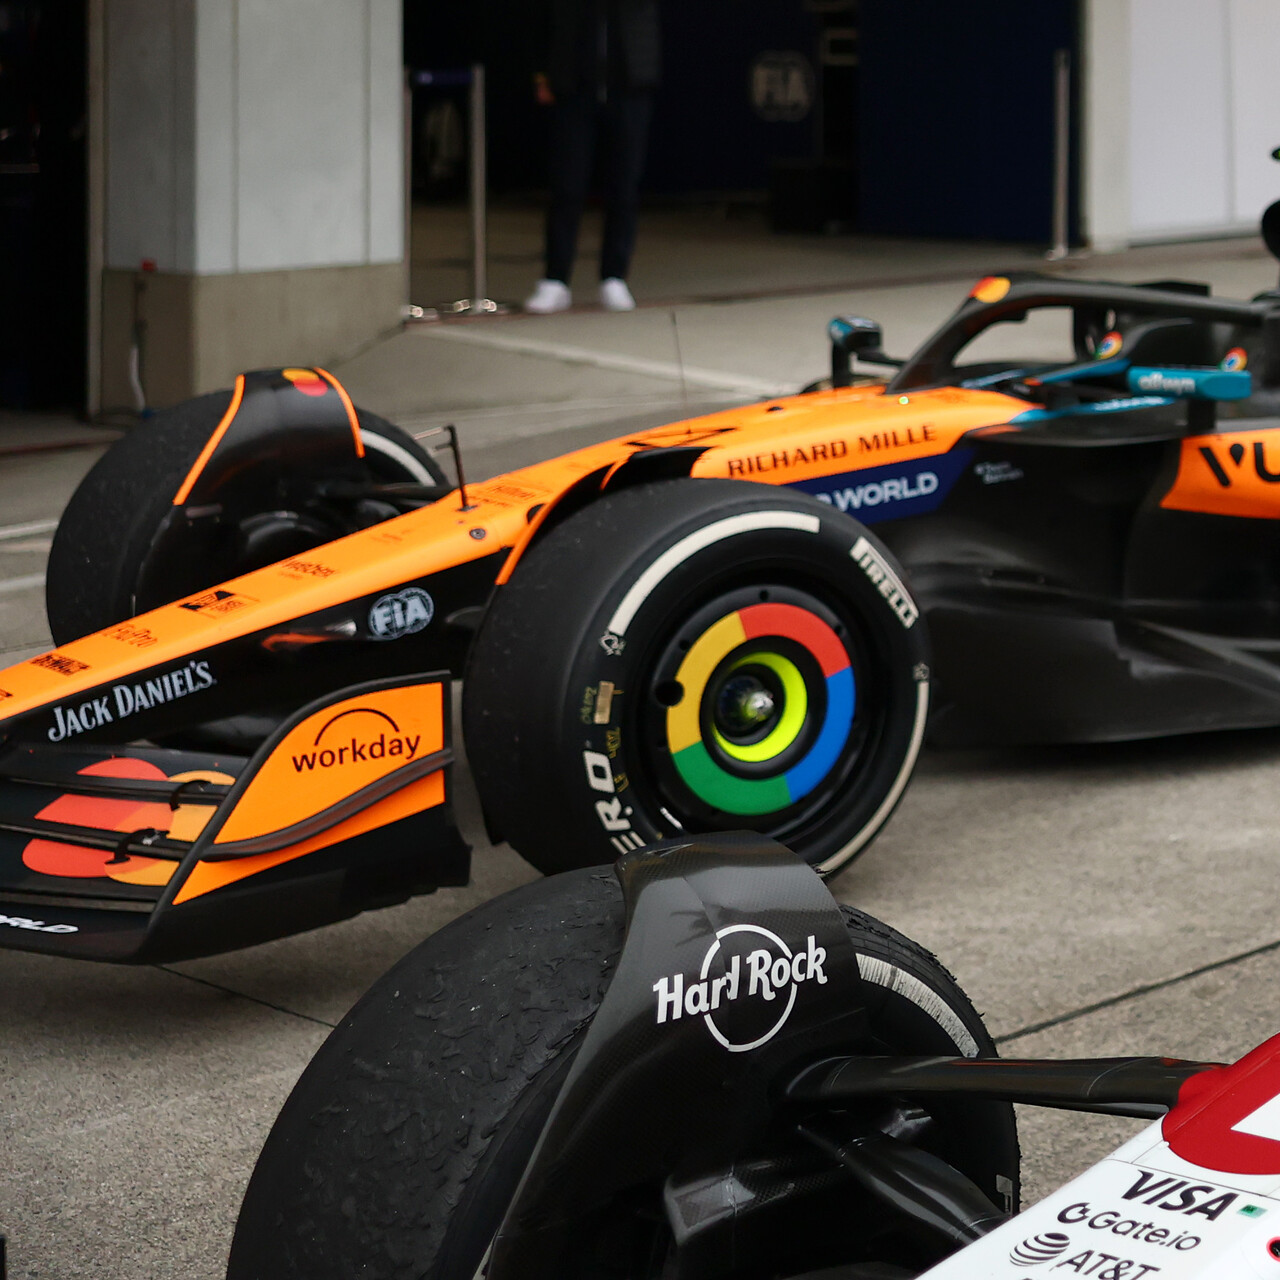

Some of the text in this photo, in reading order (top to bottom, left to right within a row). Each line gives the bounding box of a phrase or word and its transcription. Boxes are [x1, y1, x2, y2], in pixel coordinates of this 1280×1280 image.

[727, 424, 937, 478] RICHARD MILLE
[833, 471, 940, 513] WORLD
[373, 595, 431, 633] FIA
[48, 694, 113, 743] JACK
[113, 660, 213, 719] DANIEL'S
[291, 731, 421, 773] workday
[653, 935, 828, 1025] Hard Rock
[1121, 1168, 1240, 1222] VISA
[1087, 1210, 1202, 1252] Gate.io
[1053, 1249, 1162, 1280] AT&T
